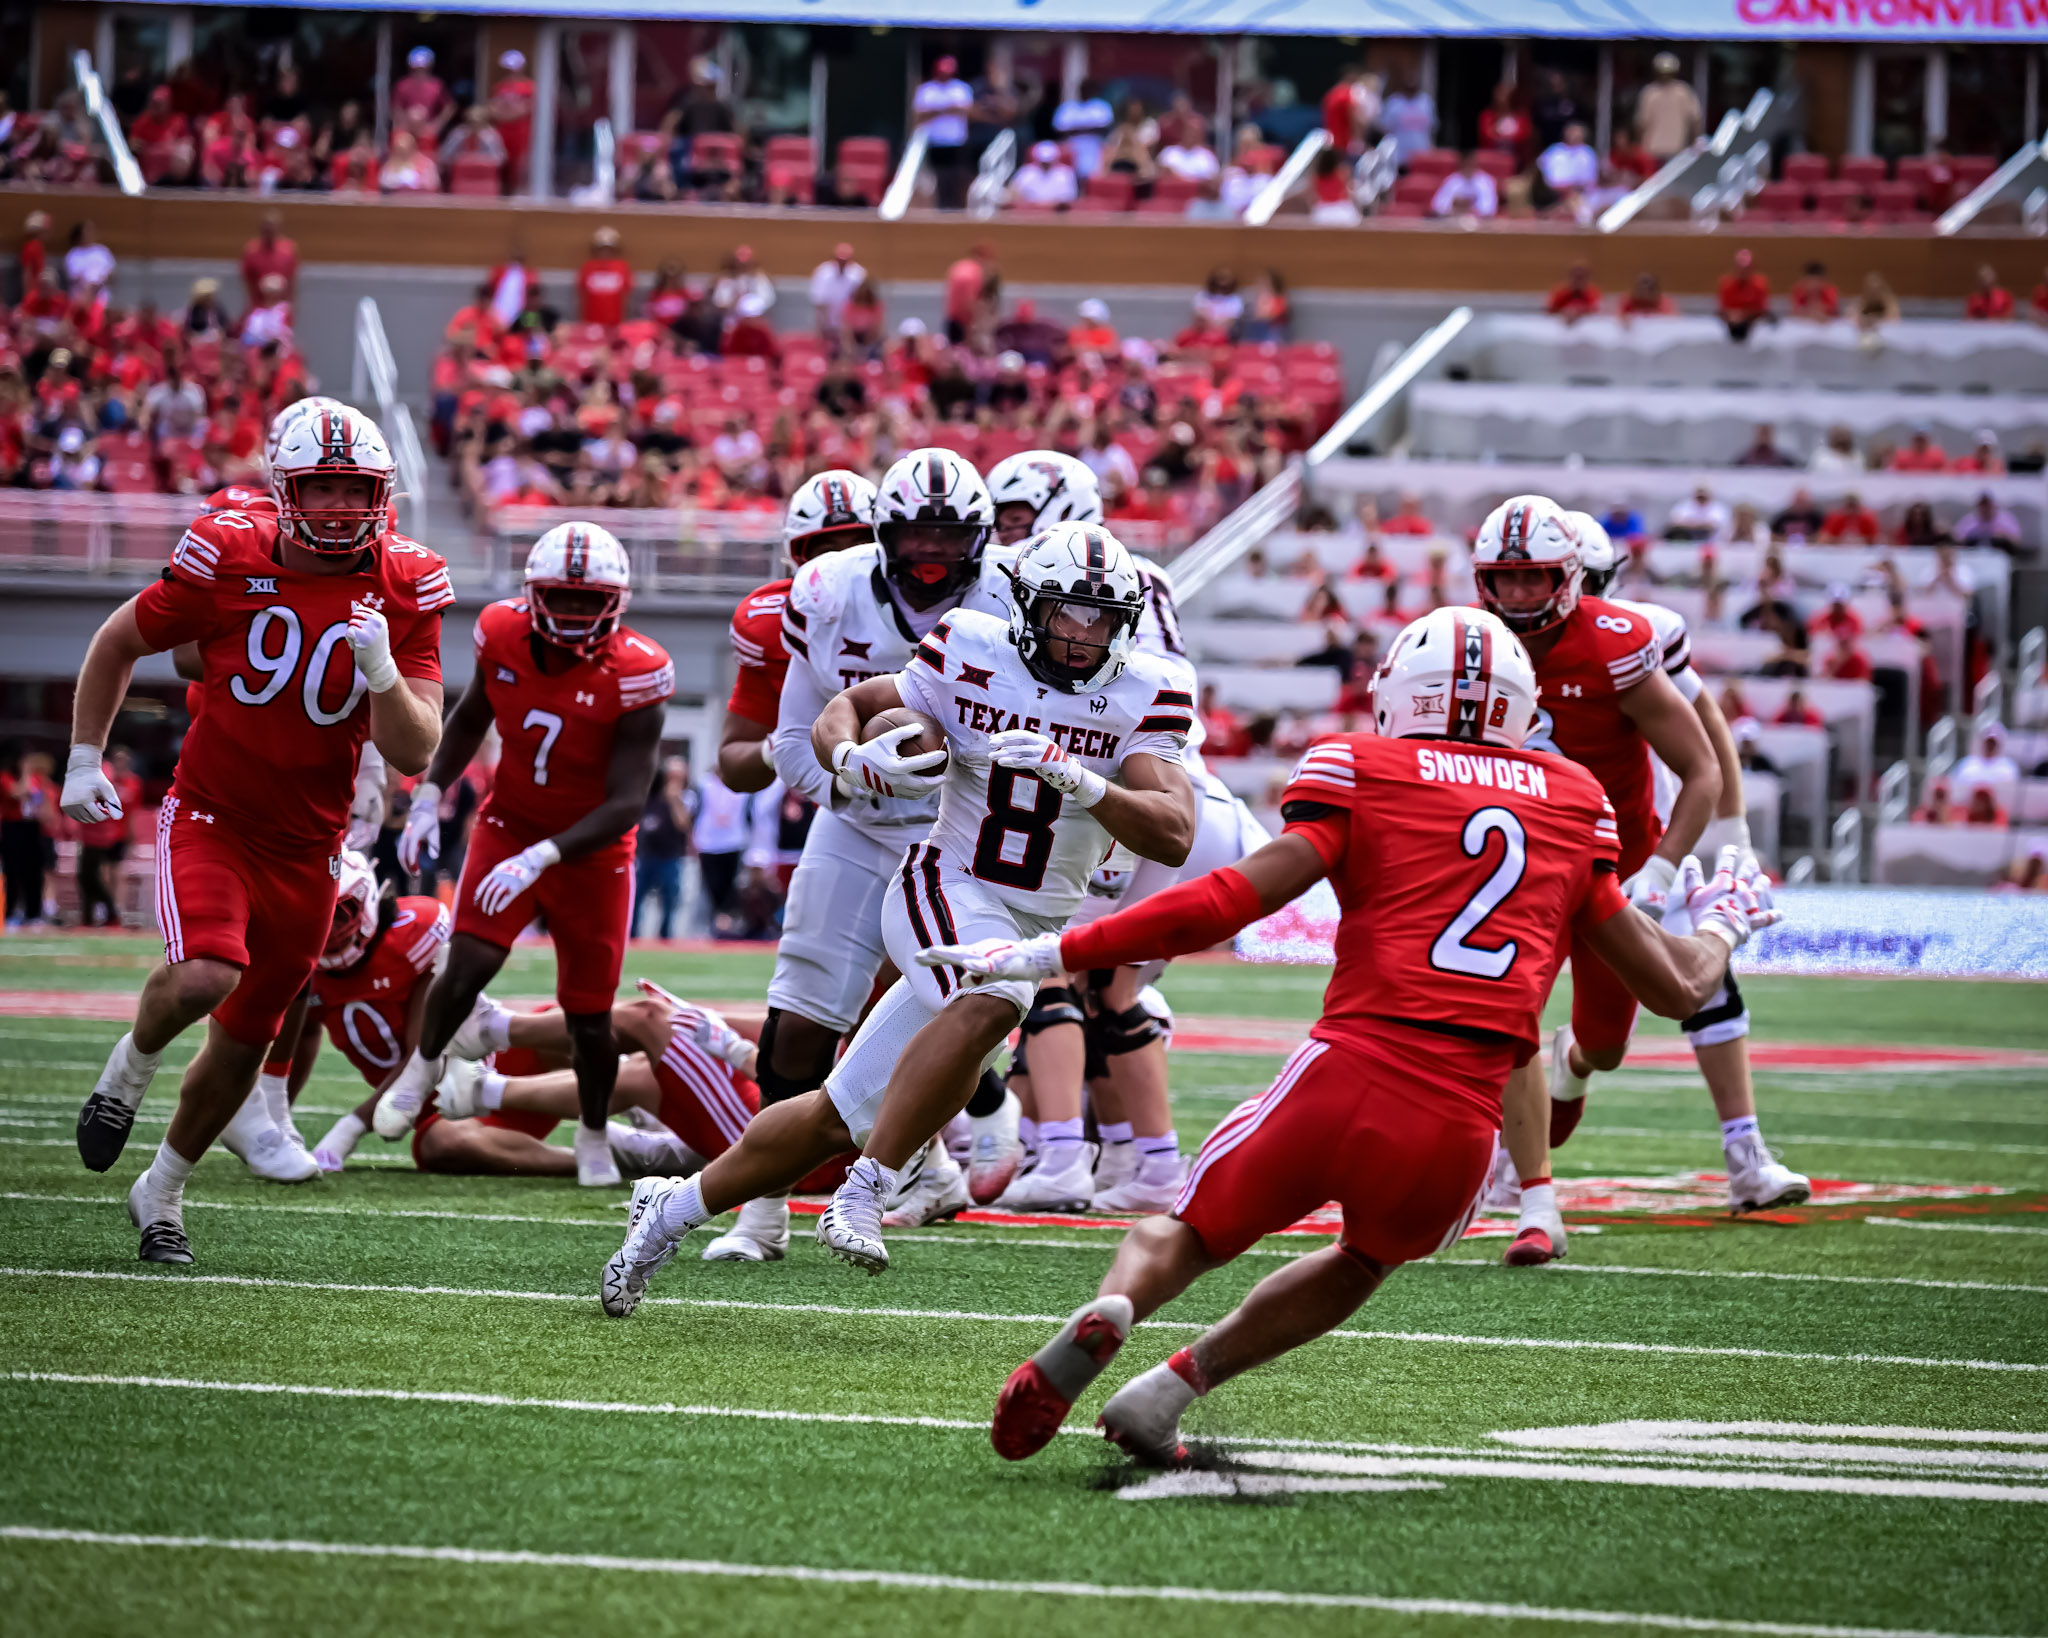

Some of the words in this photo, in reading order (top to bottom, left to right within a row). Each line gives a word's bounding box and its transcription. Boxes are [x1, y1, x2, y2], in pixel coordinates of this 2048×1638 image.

[245, 577, 279, 595] XII
[1595, 615, 1633, 635] 8
[229, 604, 369, 727] 90
[954, 696, 1042, 735] TEXAS
[1048, 722, 1121, 760] TECH
[1488, 697, 1509, 728] 2
[522, 708, 564, 787] 7
[1416, 748, 1548, 800] SNOWDEN
[971, 760, 1064, 892] 8
[1427, 805, 1528, 982] 2
[342, 1000, 401, 1070] 0
